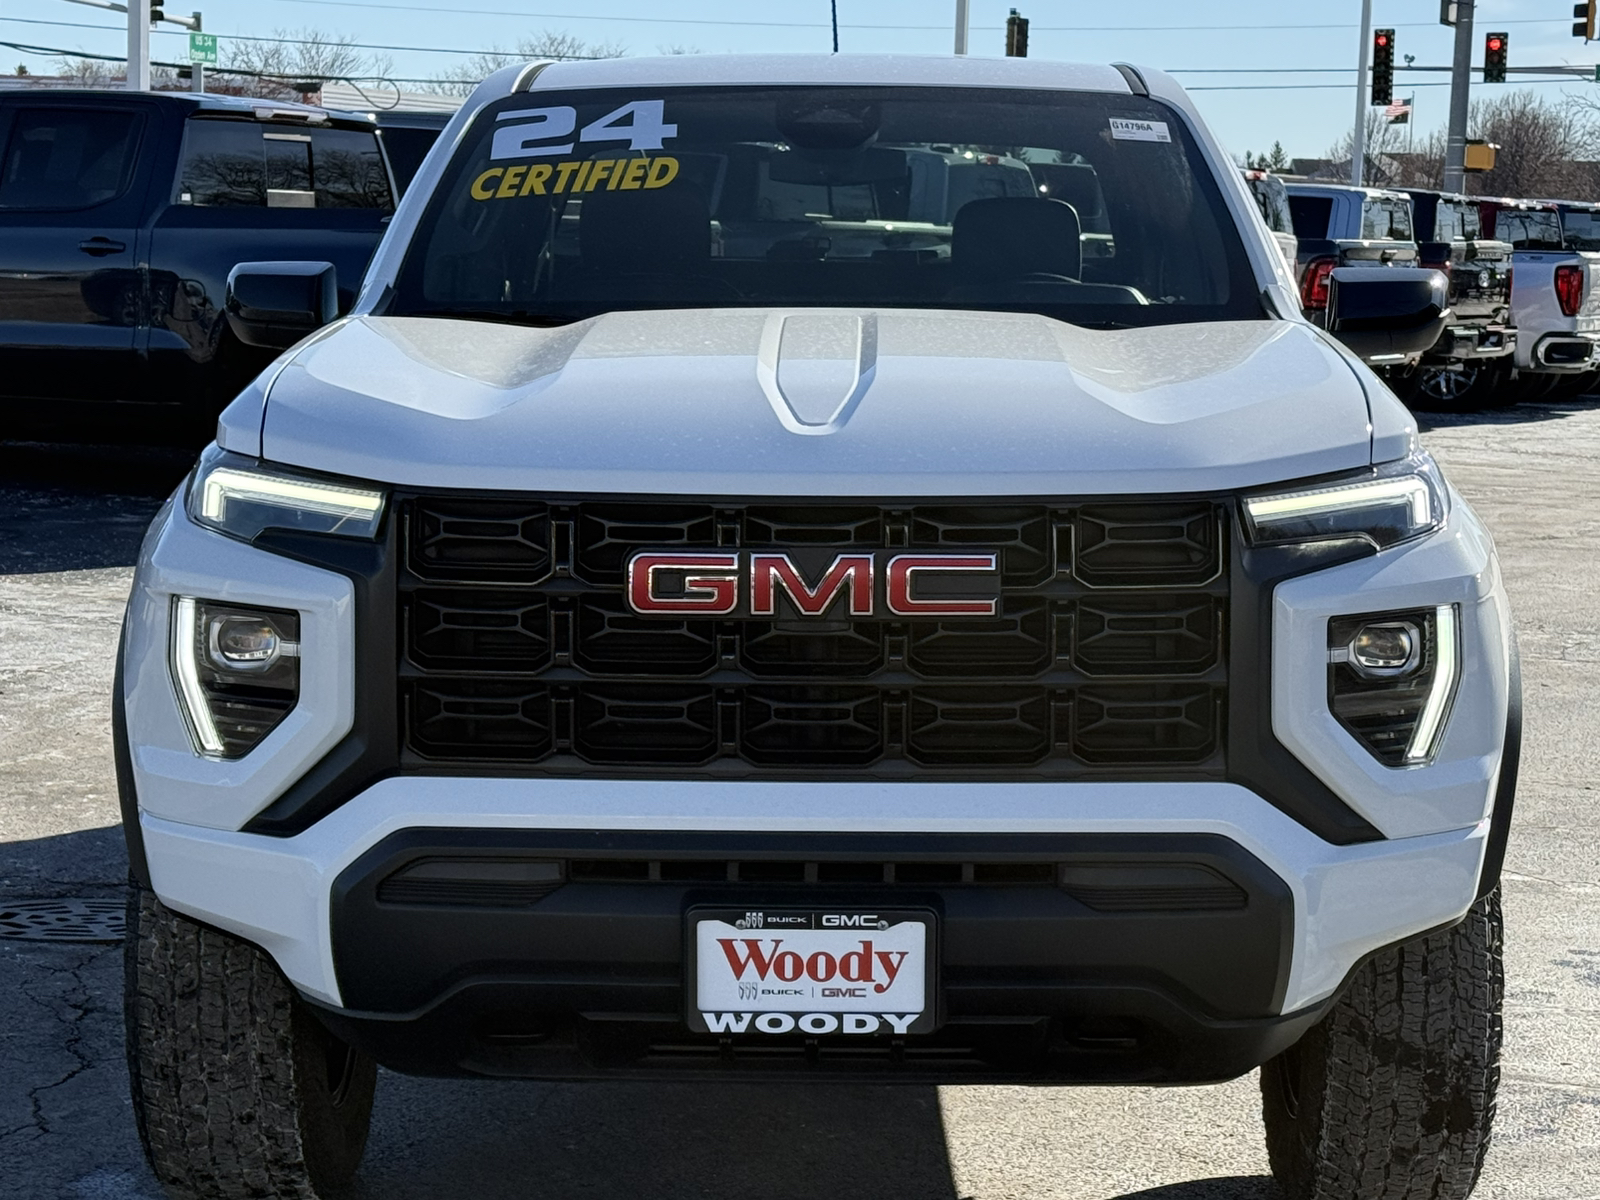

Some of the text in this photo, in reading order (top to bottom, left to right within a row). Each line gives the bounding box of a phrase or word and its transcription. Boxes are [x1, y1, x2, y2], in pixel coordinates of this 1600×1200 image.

[490, 100, 677, 160] 24
[1112, 121, 1153, 131] G14796A
[470, 157, 680, 200] CERTIFIED
[628, 552, 998, 616] GMC
[767, 914, 879, 927] BUICK GMC
[716, 938, 909, 994] Woody
[761, 987, 867, 998] BUICK GMC
[702, 1012, 920, 1035] WOODY
